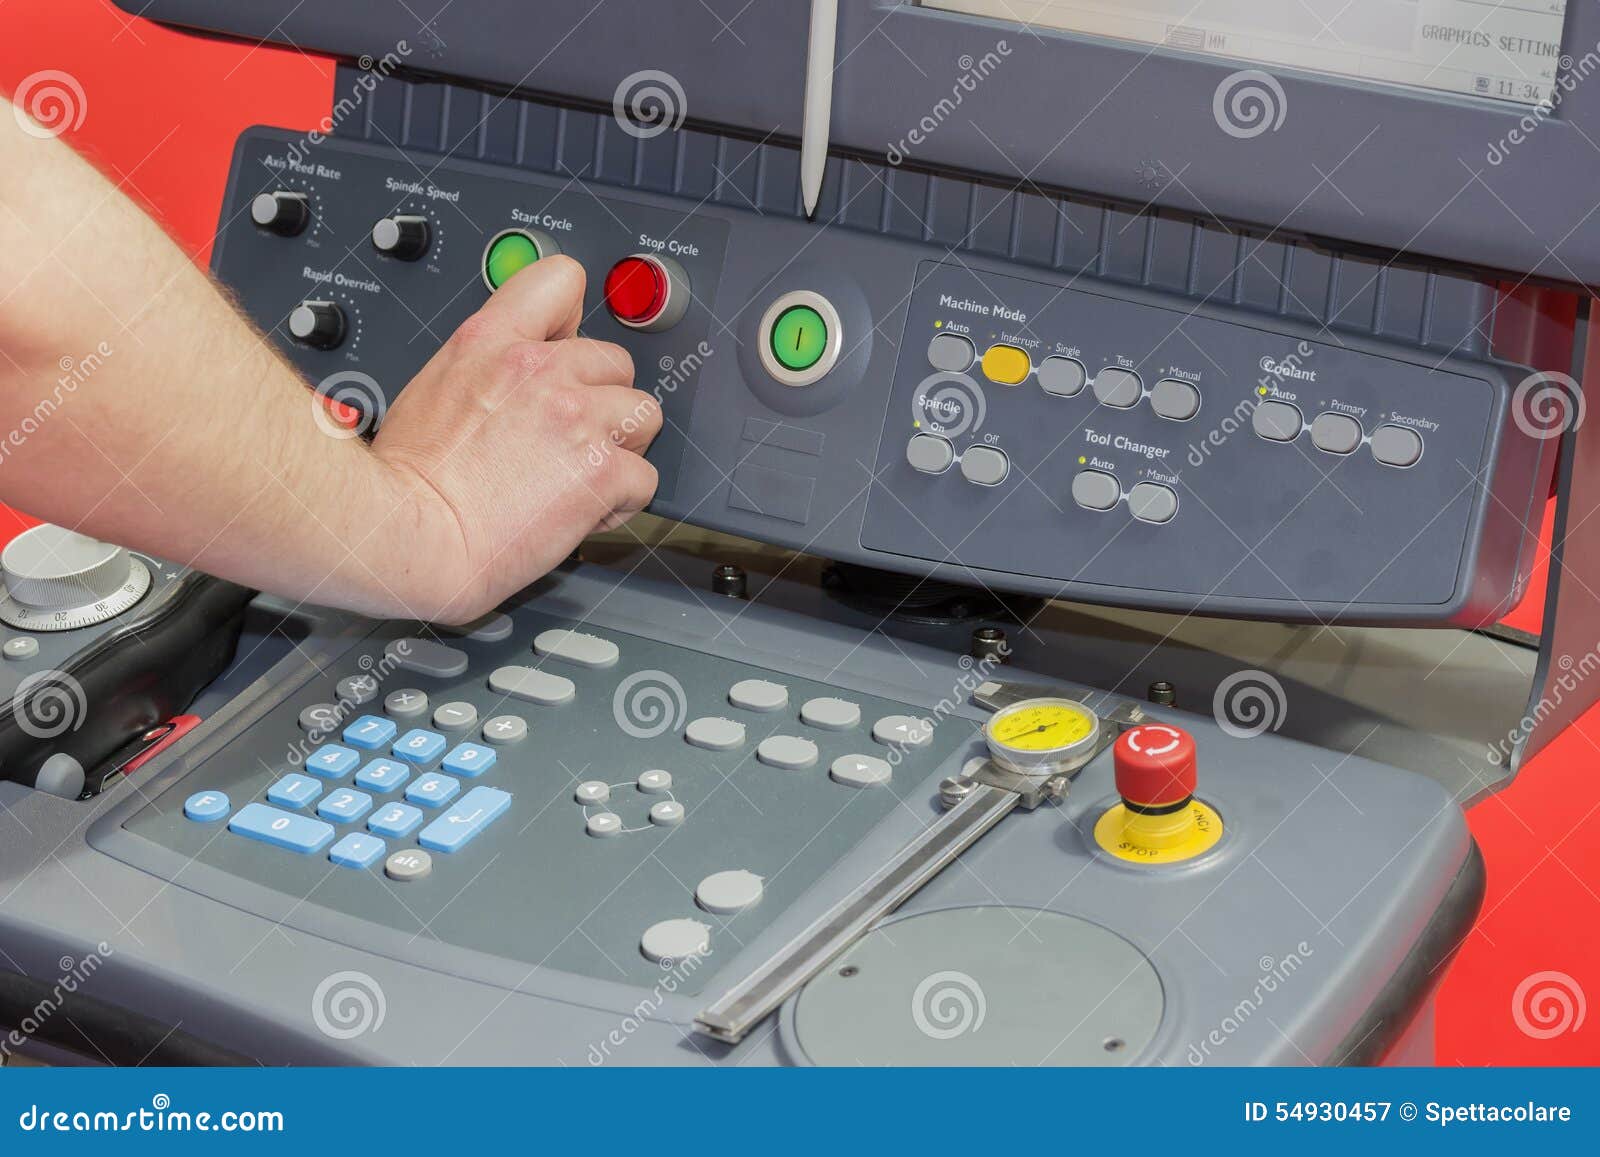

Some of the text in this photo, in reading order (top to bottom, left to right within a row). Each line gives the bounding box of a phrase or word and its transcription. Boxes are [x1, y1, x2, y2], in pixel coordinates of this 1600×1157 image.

[1422, 24, 1491, 48] GRAPHICS
[1499, 81, 1540, 100] 11:34
[264, 155, 341, 180] Axis Feed Rate
[386, 178, 460, 202] Spindle Speed
[511, 208, 573, 231] Start Cycle
[639, 234, 699, 256] Stop Cycle
[303, 266, 381, 294] Rapid Override
[940, 294, 1026, 323] Machine Mode
[946, 320, 970, 333] Auto
[1001, 332, 1040, 349] Interrupt
[1055, 342, 1081, 357] Single
[1116, 355, 1134, 368] Test
[1169, 366, 1201, 382] Manual
[1264, 360, 1317, 382] Coolant
[1271, 387, 1297, 401] Auto
[918, 394, 961, 415] Spindle
[1331, 400, 1368, 417] Primary
[930, 422, 945, 433] On
[1391, 412, 1440, 432] Secondary
[984, 433, 1000, 445] Off
[1085, 429, 1170, 459] Tool Changer
[1090, 457, 1115, 470] Auto
[1147, 469, 1179, 485] Manual
[95, 601, 108, 612] 30
[55, 611, 68, 622] 20
[360, 722, 379, 733] 7
[409, 736, 428, 748] 8
[322, 752, 342, 764] 4
[460, 750, 478, 762] 9
[370, 766, 391, 779] 5
[285, 781, 301, 794] 1
[422, 781, 440, 793] 6
[195, 796, 216, 808] F
[334, 795, 353, 809] 2
[384, 809, 404, 822] 3
[271, 819, 290, 831] 0
[1119, 842, 1158, 856] STOP
[395, 855, 420, 868] alt
